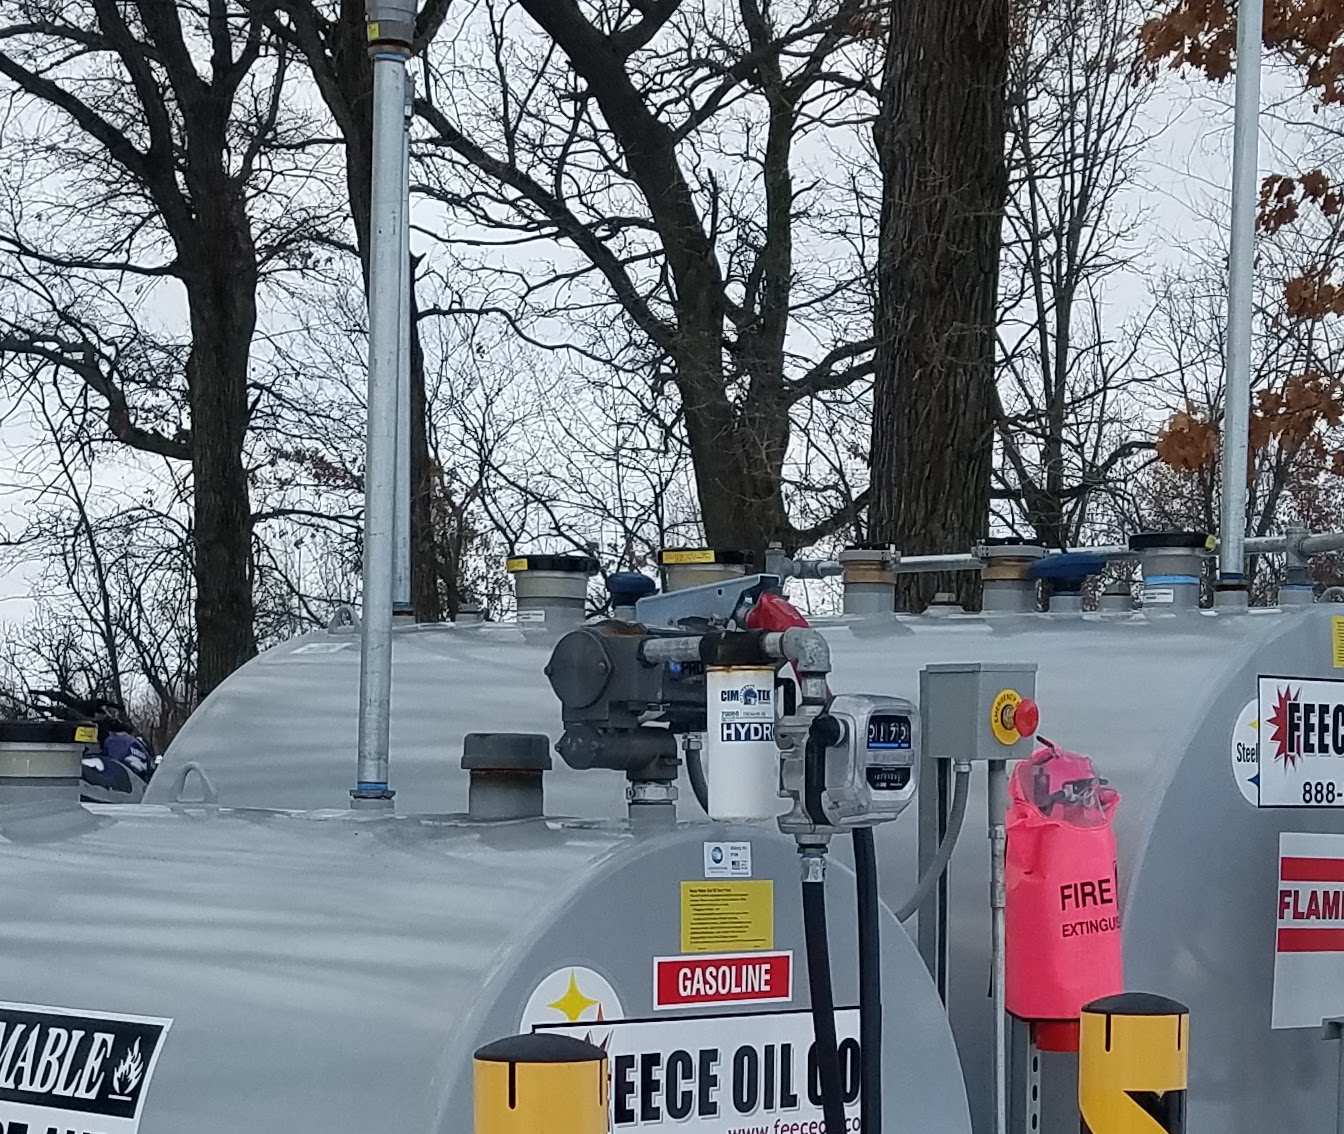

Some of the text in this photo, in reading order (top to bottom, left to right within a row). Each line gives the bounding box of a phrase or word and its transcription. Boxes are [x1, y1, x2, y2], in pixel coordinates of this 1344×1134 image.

[721, 690, 739, 702] CIM
[723, 723, 775, 741] HYDR
[1236, 742, 1258, 763] Steel
[1060, 878, 1113, 911] FIRE
[678, 963, 771, 997] GASOLINE
[613, 1048, 720, 1125] EECE
[732, 1042, 798, 1114] OIL
